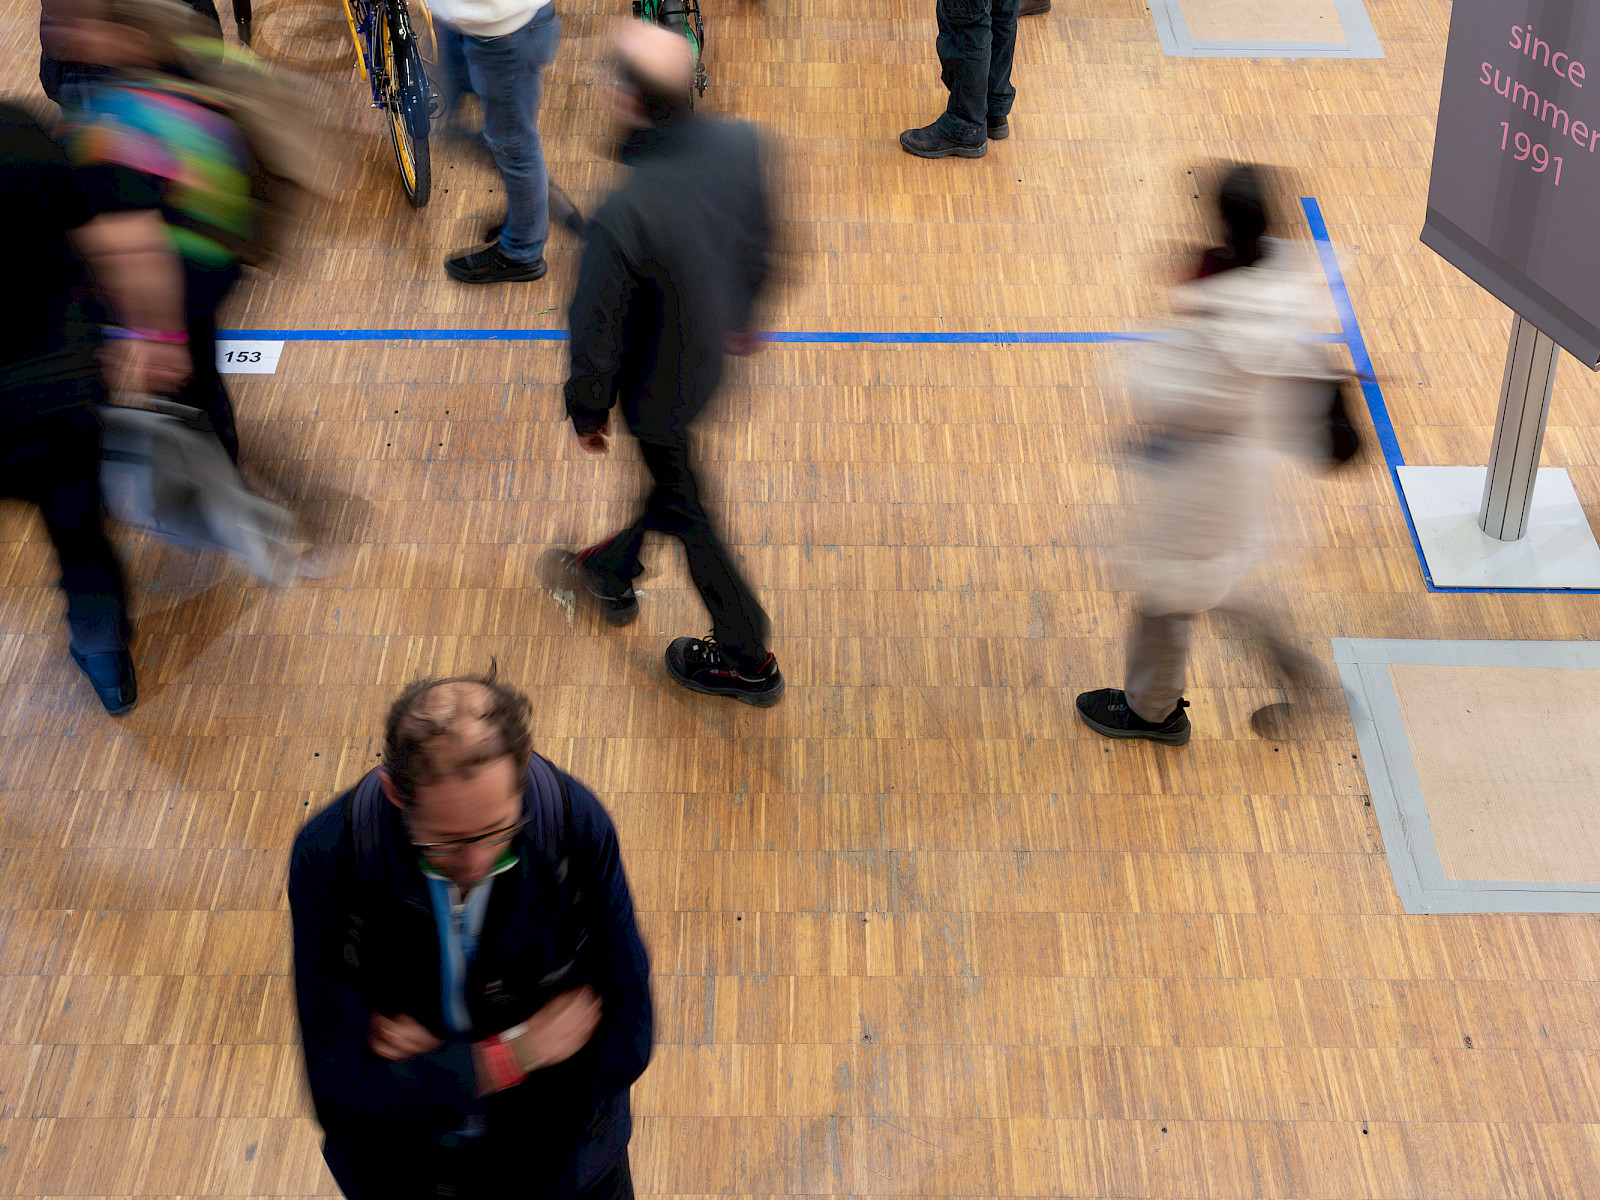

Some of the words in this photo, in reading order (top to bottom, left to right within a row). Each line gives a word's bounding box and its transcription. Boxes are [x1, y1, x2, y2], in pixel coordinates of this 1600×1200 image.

[1508, 24, 1586, 89] since
[1479, 61, 1600, 153] summer
[1500, 120, 1564, 187] 1991
[224, 350, 262, 363] 153
